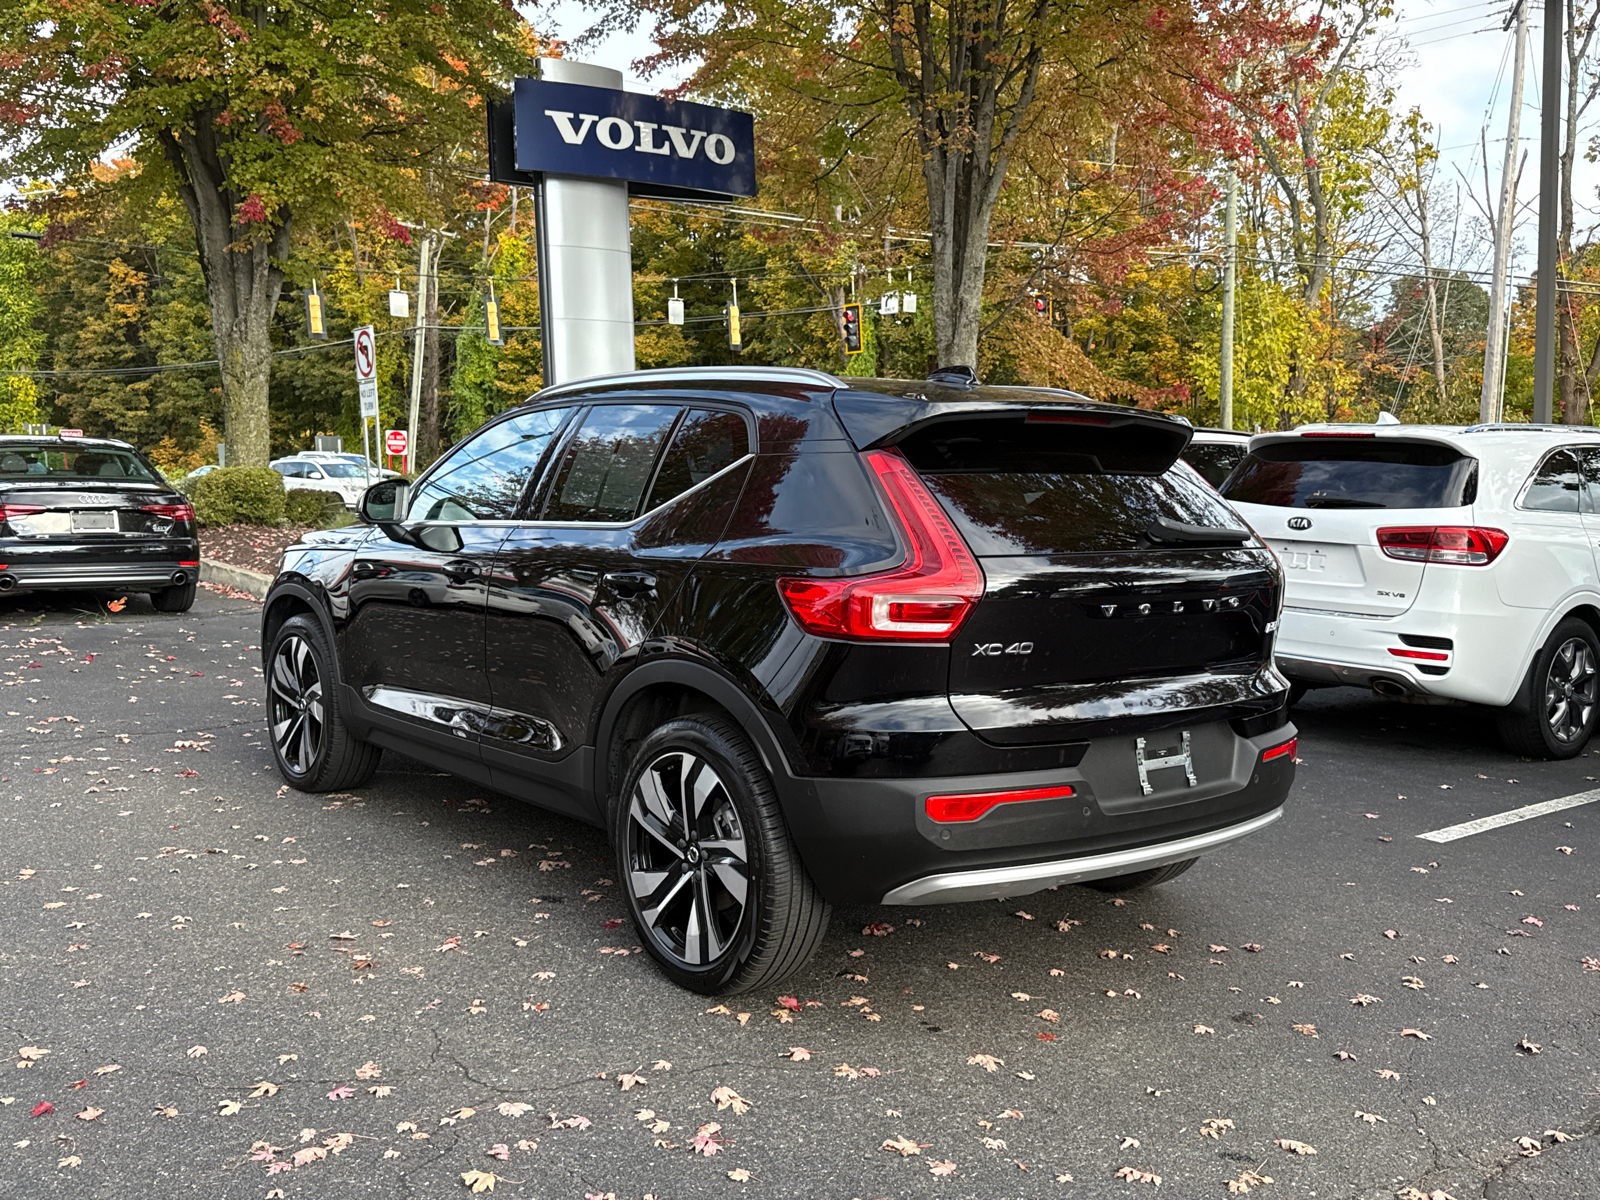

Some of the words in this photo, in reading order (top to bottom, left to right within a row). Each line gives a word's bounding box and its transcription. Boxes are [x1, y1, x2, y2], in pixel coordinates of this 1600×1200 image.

[544, 109, 736, 165] VOLVO
[361, 389, 366, 398] NO
[367, 388, 375, 397] LEFT
[364, 402, 374, 411] TURN
[1289, 518, 1308, 528] KIA
[1100, 596, 1240, 618] VOLVO
